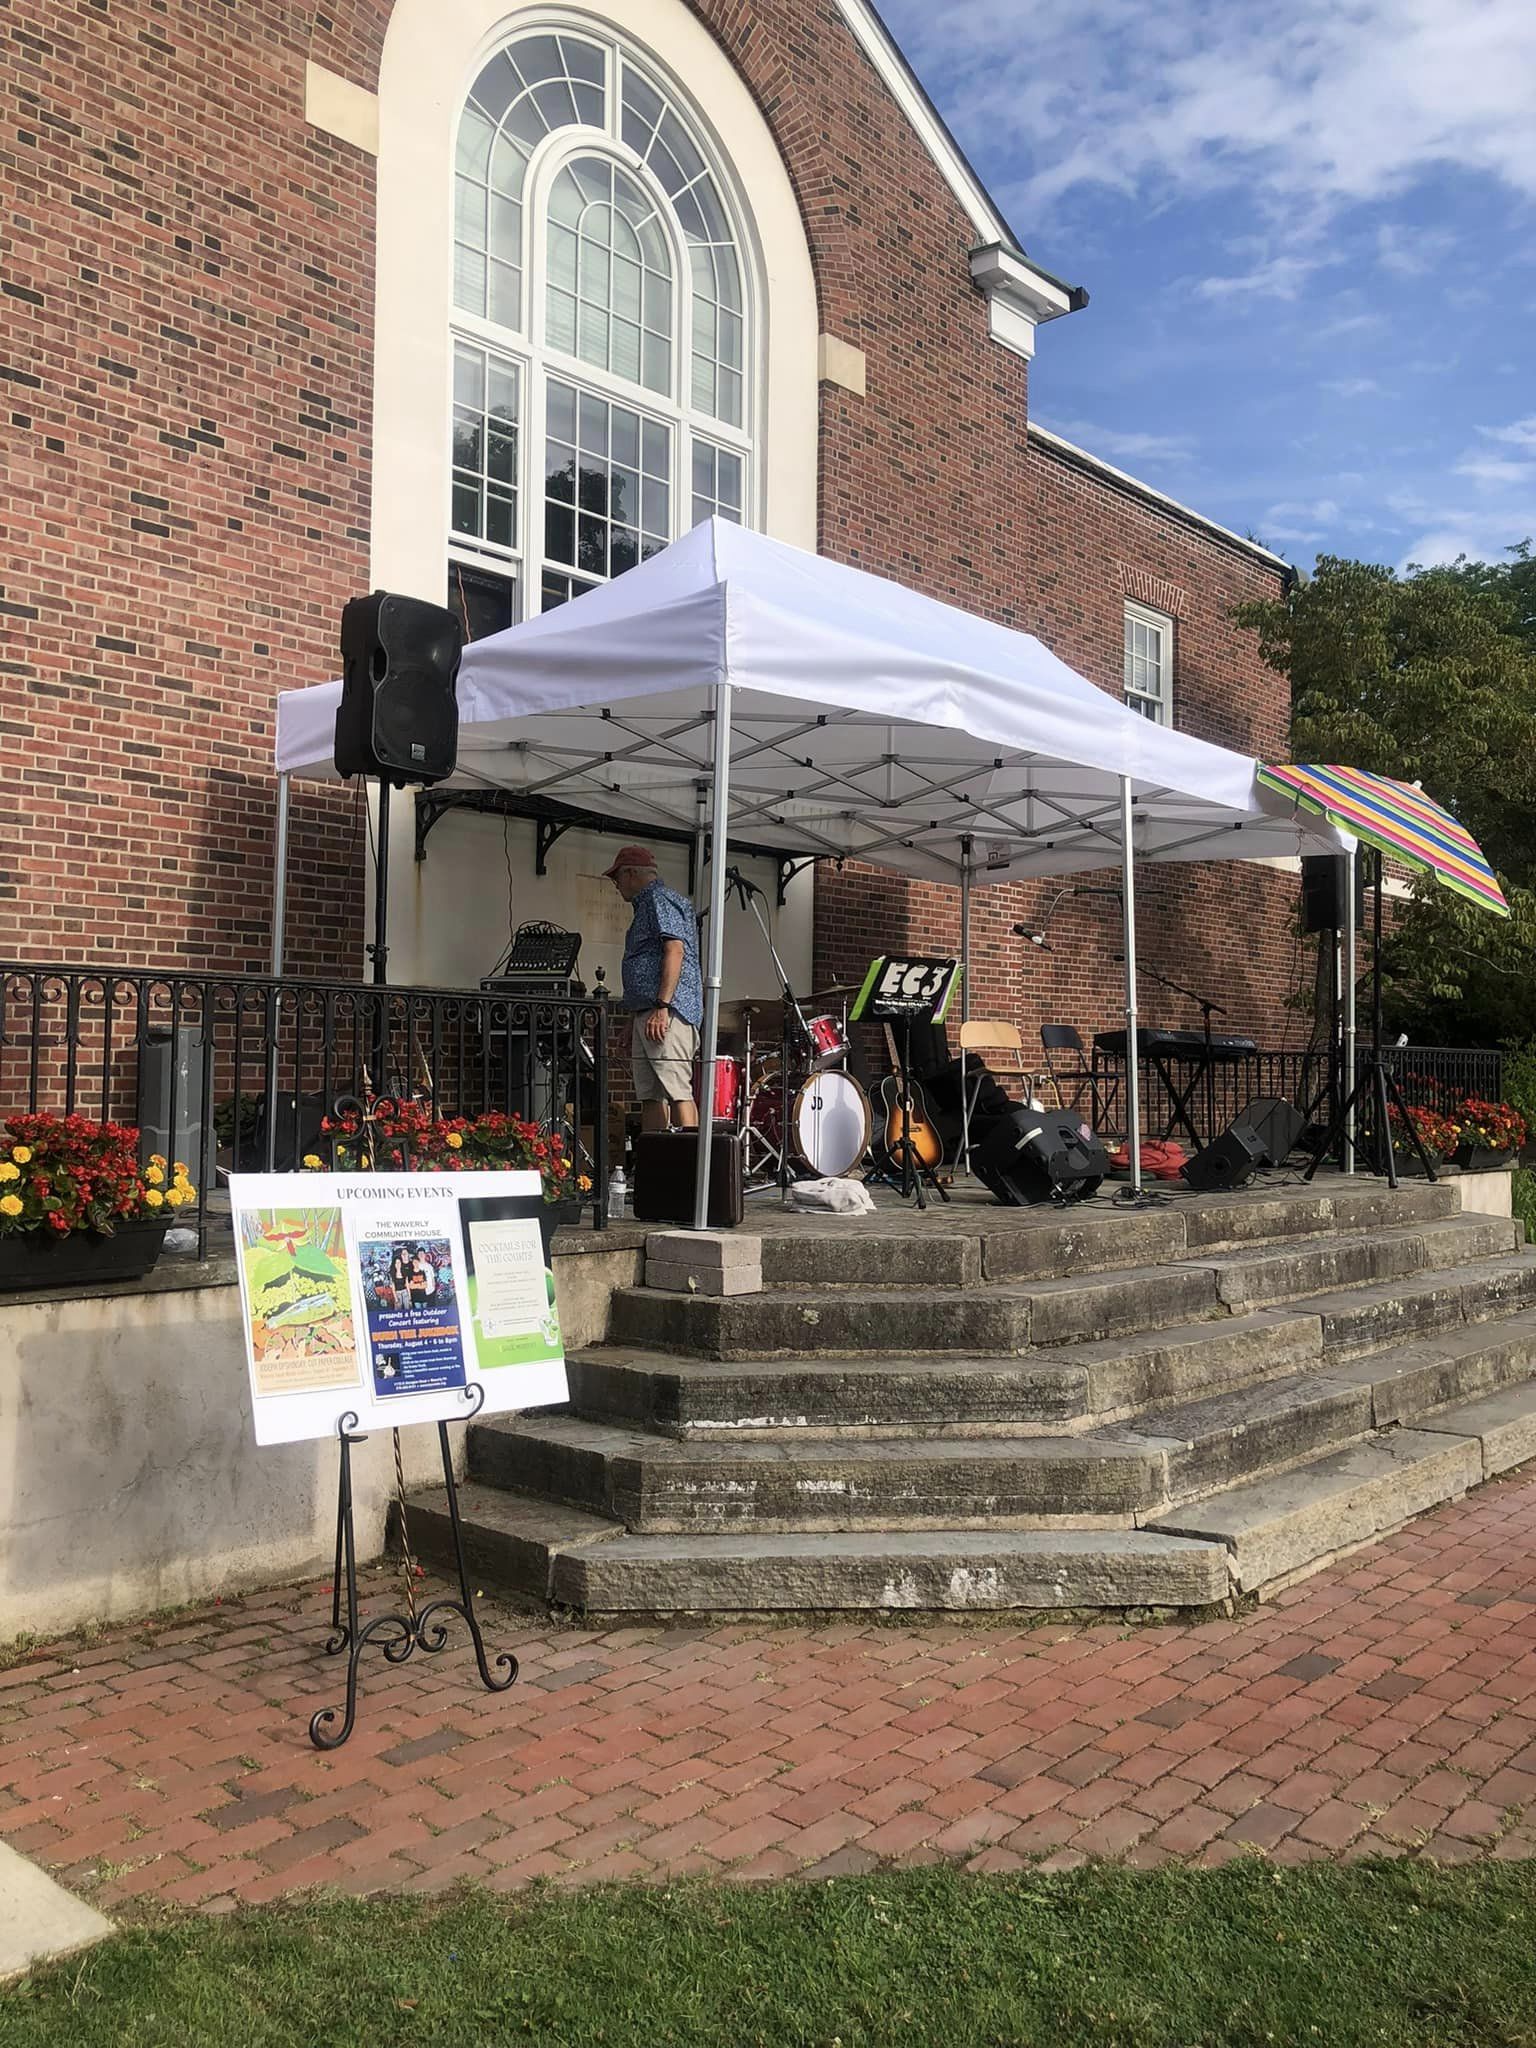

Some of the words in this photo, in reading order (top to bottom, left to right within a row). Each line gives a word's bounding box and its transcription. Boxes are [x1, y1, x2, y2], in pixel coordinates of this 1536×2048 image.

[879, 962, 950, 996] EC3
[811, 1095, 823, 1111] JD
[337, 1187, 404, 1200] UPCOMING
[407, 1186, 453, 1199] EVENTS
[376, 1221, 392, 1229] THE
[392, 1220, 429, 1228] WAVERLY
[364, 1231, 413, 1239] COMMUNITY
[414, 1229, 442, 1237] HOUSE
[422, 1308, 448, 1316] Outdoor
[388, 1319, 412, 1327] Concert
[412, 1317, 439, 1326] featuring
[404, 1339, 423, 1348] August
